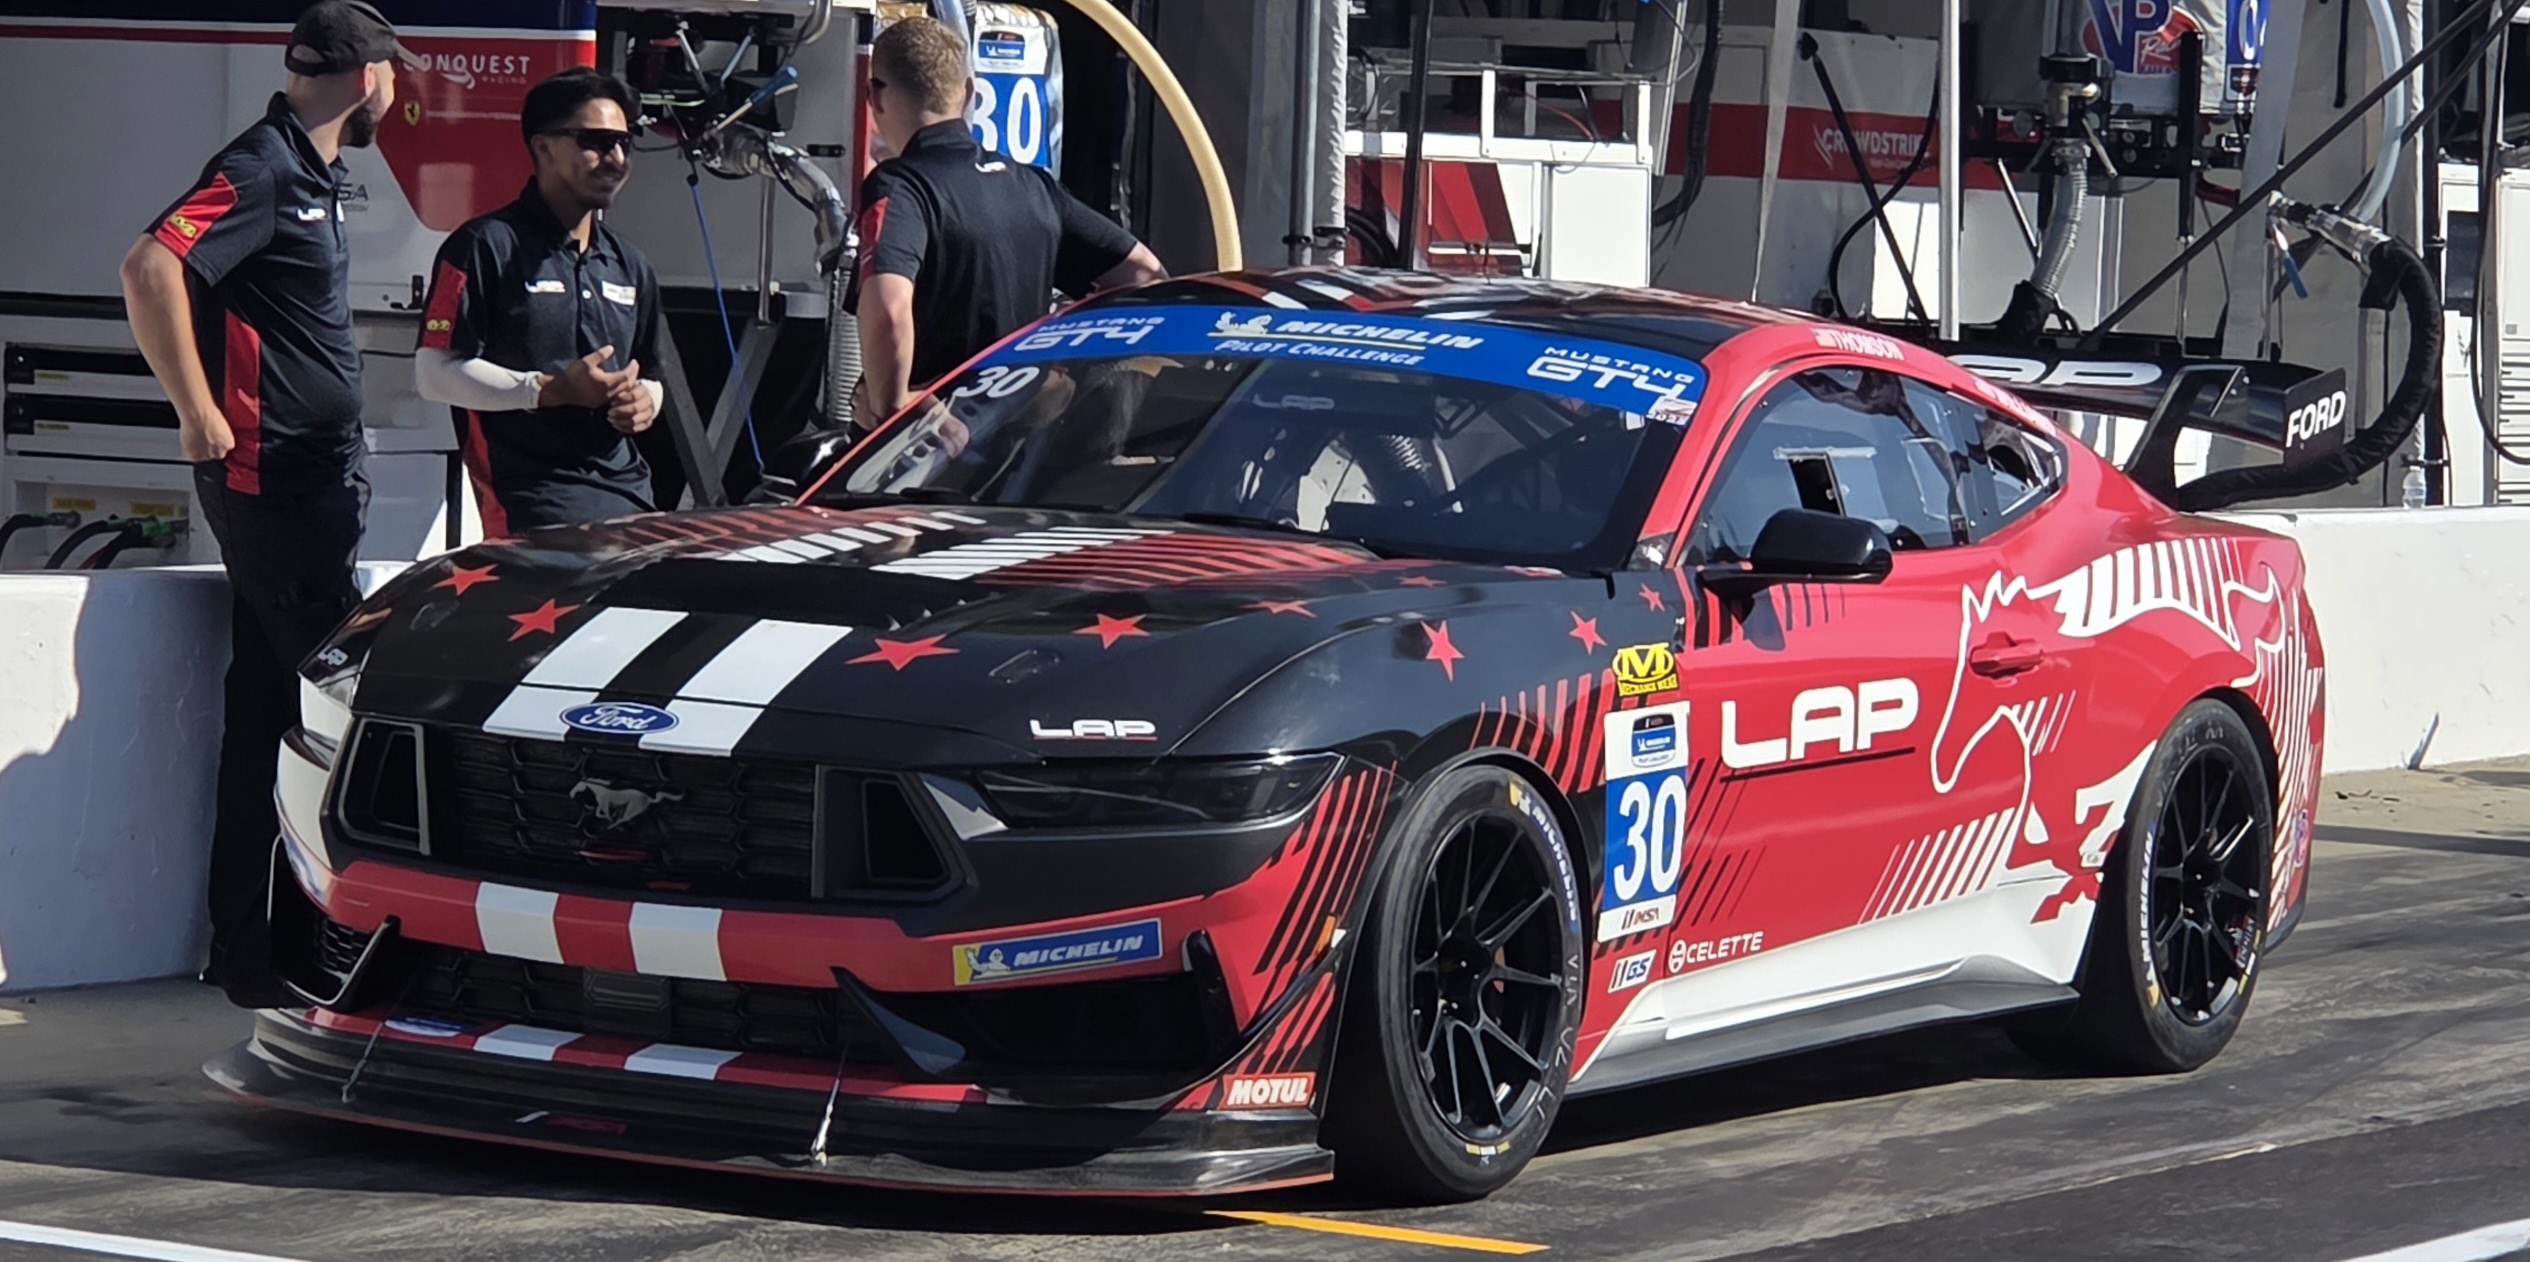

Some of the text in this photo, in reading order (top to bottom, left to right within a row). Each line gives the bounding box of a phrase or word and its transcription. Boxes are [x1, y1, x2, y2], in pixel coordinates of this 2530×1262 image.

[403, 53, 531, 80] ONQUEST
[1014, 325, 1155, 351] GT4
[1276, 320, 1484, 349] MICHELIN
[1831, 330, 1905, 361] THOMSON
[1214, 339, 1425, 366] PILOT CHALLENGE
[1544, 346, 1696, 384] MUSTANG
[952, 365, 1040, 398] 30
[1526, 356, 1687, 400] GT4
[1947, 354, 2163, 387] AP
[2286, 390, 2347, 449] FORD
[579, 704, 658, 730] Ford
[1029, 719, 1157, 738] LAP
[1721, 677, 1920, 769] LAP
[1614, 774, 1687, 901] 30
[1013, 934, 1143, 967] MICHELIN
[1686, 930, 1763, 964] CELETTE
[1626, 955, 1651, 981] GS
[1226, 1077, 1309, 1105] MOTUL
